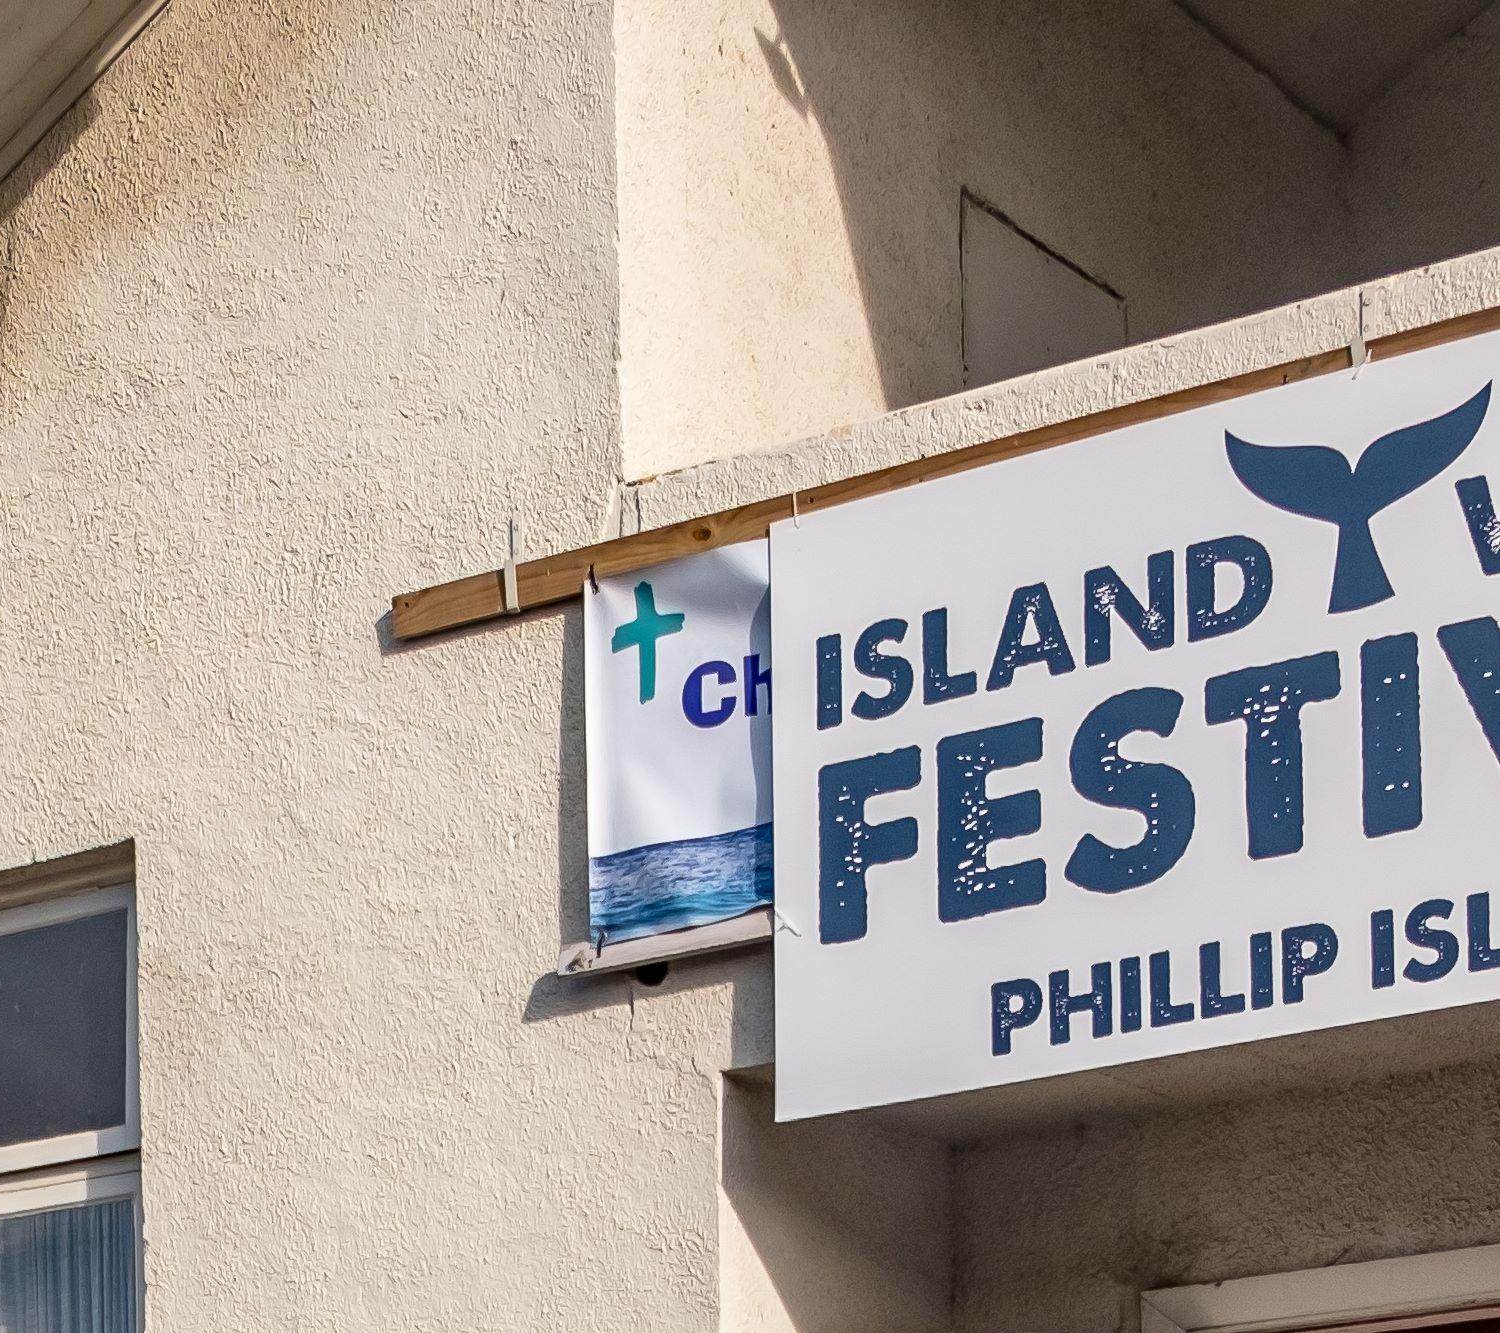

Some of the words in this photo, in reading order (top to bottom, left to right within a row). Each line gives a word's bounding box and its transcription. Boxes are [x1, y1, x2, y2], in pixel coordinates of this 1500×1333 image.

[682, 653, 771, 729] Ch
[816, 535, 1273, 730] ISLAND
[991, 923, 1338, 1056] PHILLIP
